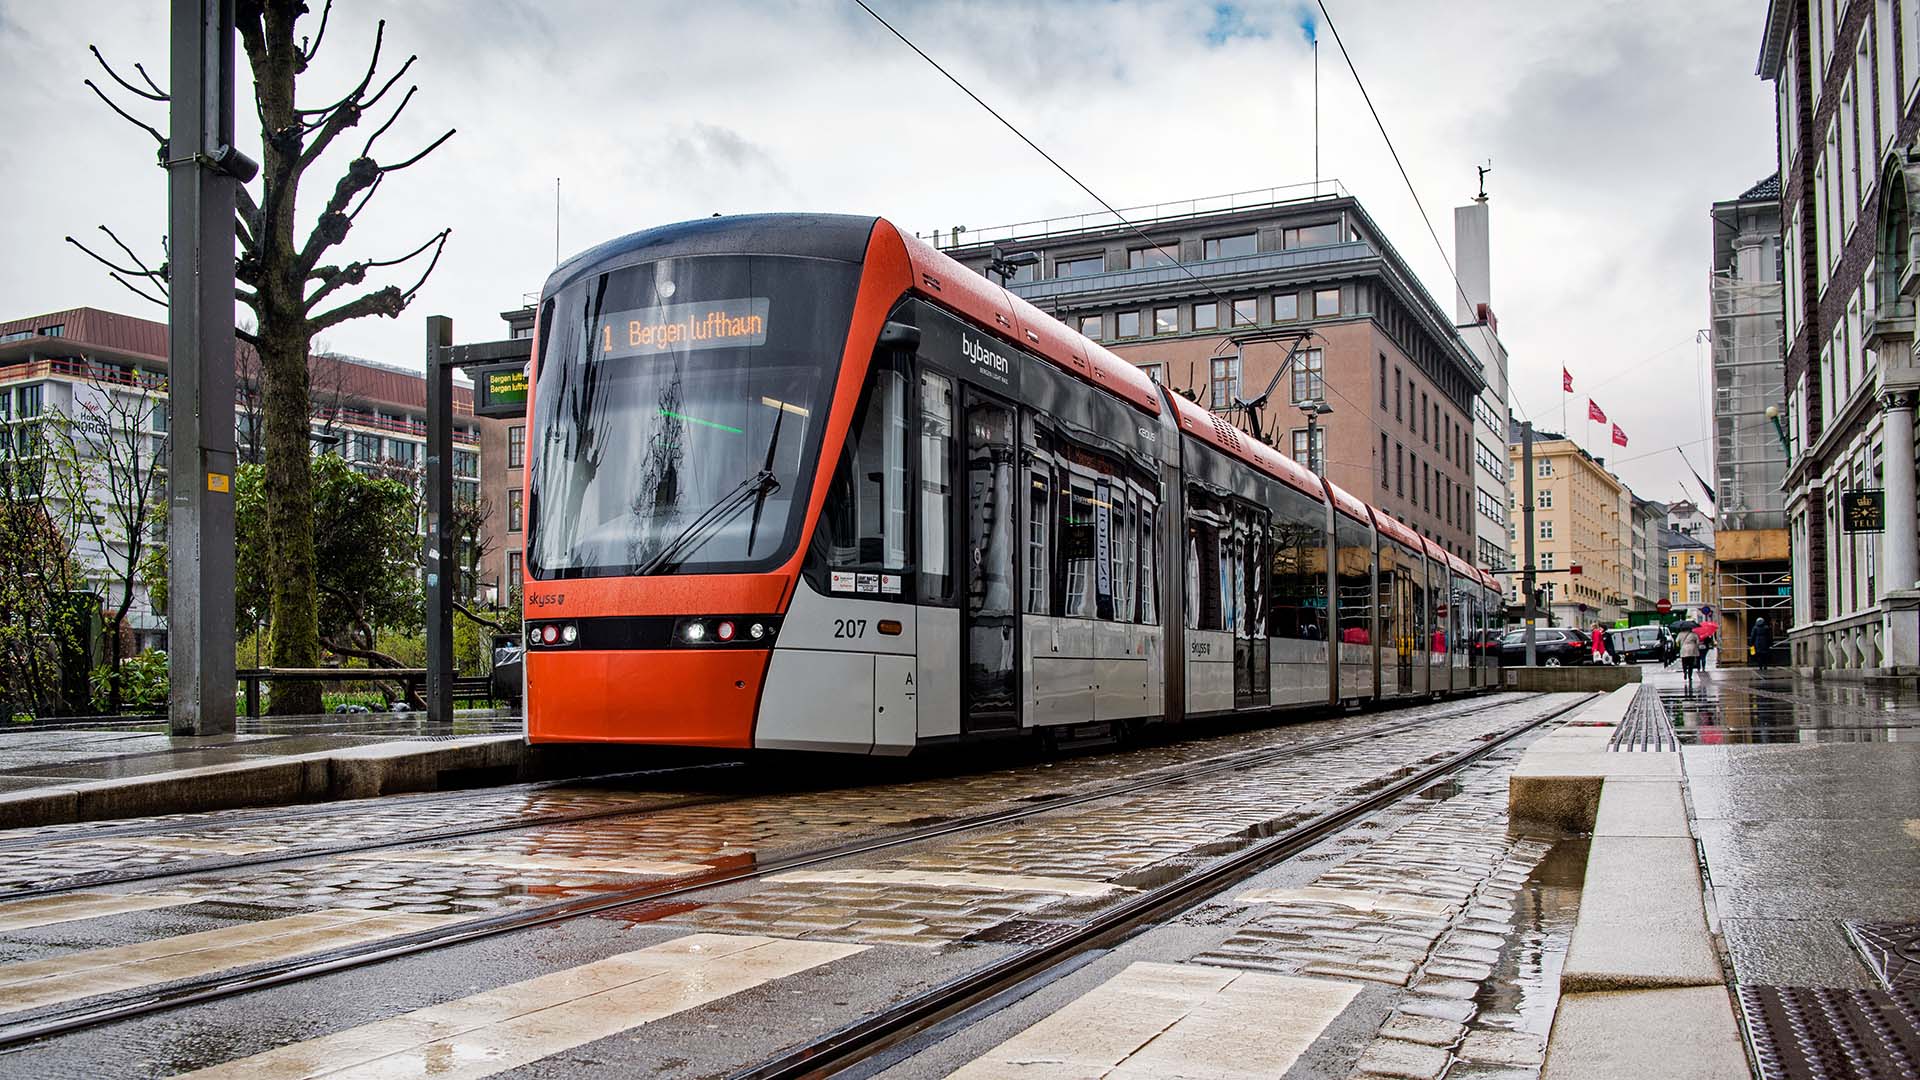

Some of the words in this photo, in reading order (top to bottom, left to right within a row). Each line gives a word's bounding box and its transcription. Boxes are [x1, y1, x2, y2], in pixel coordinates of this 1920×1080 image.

[603, 326, 613, 353] 1
[629, 319, 687, 349] Bergen
[962, 332, 1008, 374] bybanen
[490, 376, 511, 384] Bergen
[490, 385, 511, 394] Bergen
[529, 592, 556, 607] skyss
[834, 619, 867, 638] 207
[1191, 638, 1207, 657] skyss
[906, 672, 913, 685] A
